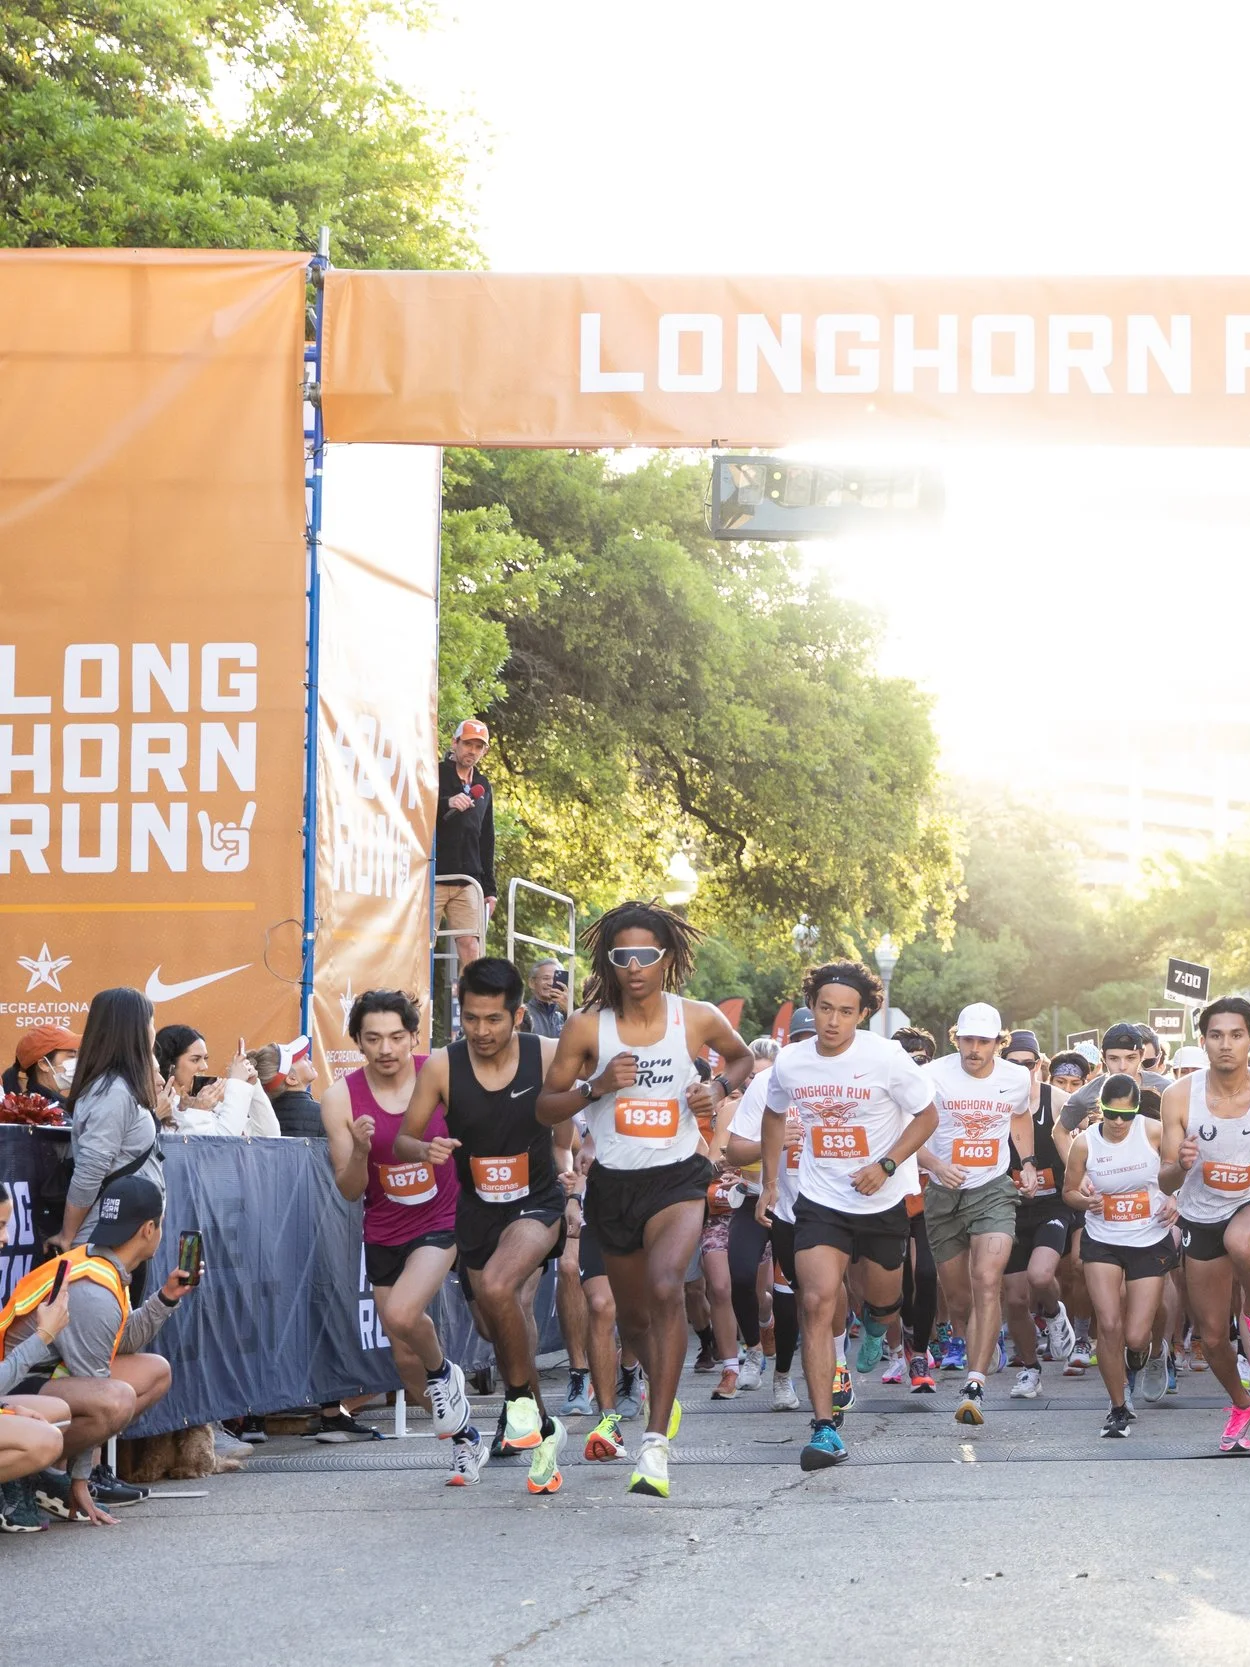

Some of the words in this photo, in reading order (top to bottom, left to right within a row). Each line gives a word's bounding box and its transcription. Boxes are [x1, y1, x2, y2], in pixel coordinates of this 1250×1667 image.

[580, 313, 1191, 394] LONGHORN
[0, 642, 257, 714] LONG
[0, 722, 256, 794] HORN
[0, 802, 188, 874] RUN
[1174, 969, 1202, 989] 7:00
[0, 1002, 89, 1014] ECREATIONA
[16, 1016, 71, 1027] SPORTS
[636, 1070, 674, 1088] Run
[791, 1085, 843, 1100] LONGHORN
[847, 1087, 871, 1100] RUN
[942, 1100, 993, 1111] LONGHORN
[996, 1102, 1013, 1113] RUN
[624, 1109, 672, 1126] 1938
[822, 1135, 856, 1149] 836
[840, 1149, 862, 1158] Taylor
[959, 1146, 993, 1158] 1403
[386, 1168, 429, 1188] 1878
[486, 1166, 511, 1182] 39
[1210, 1170, 1249, 1184] 2152
[481, 1182, 519, 1191] Barcenas
[1116, 1200, 1134, 1213] 87
